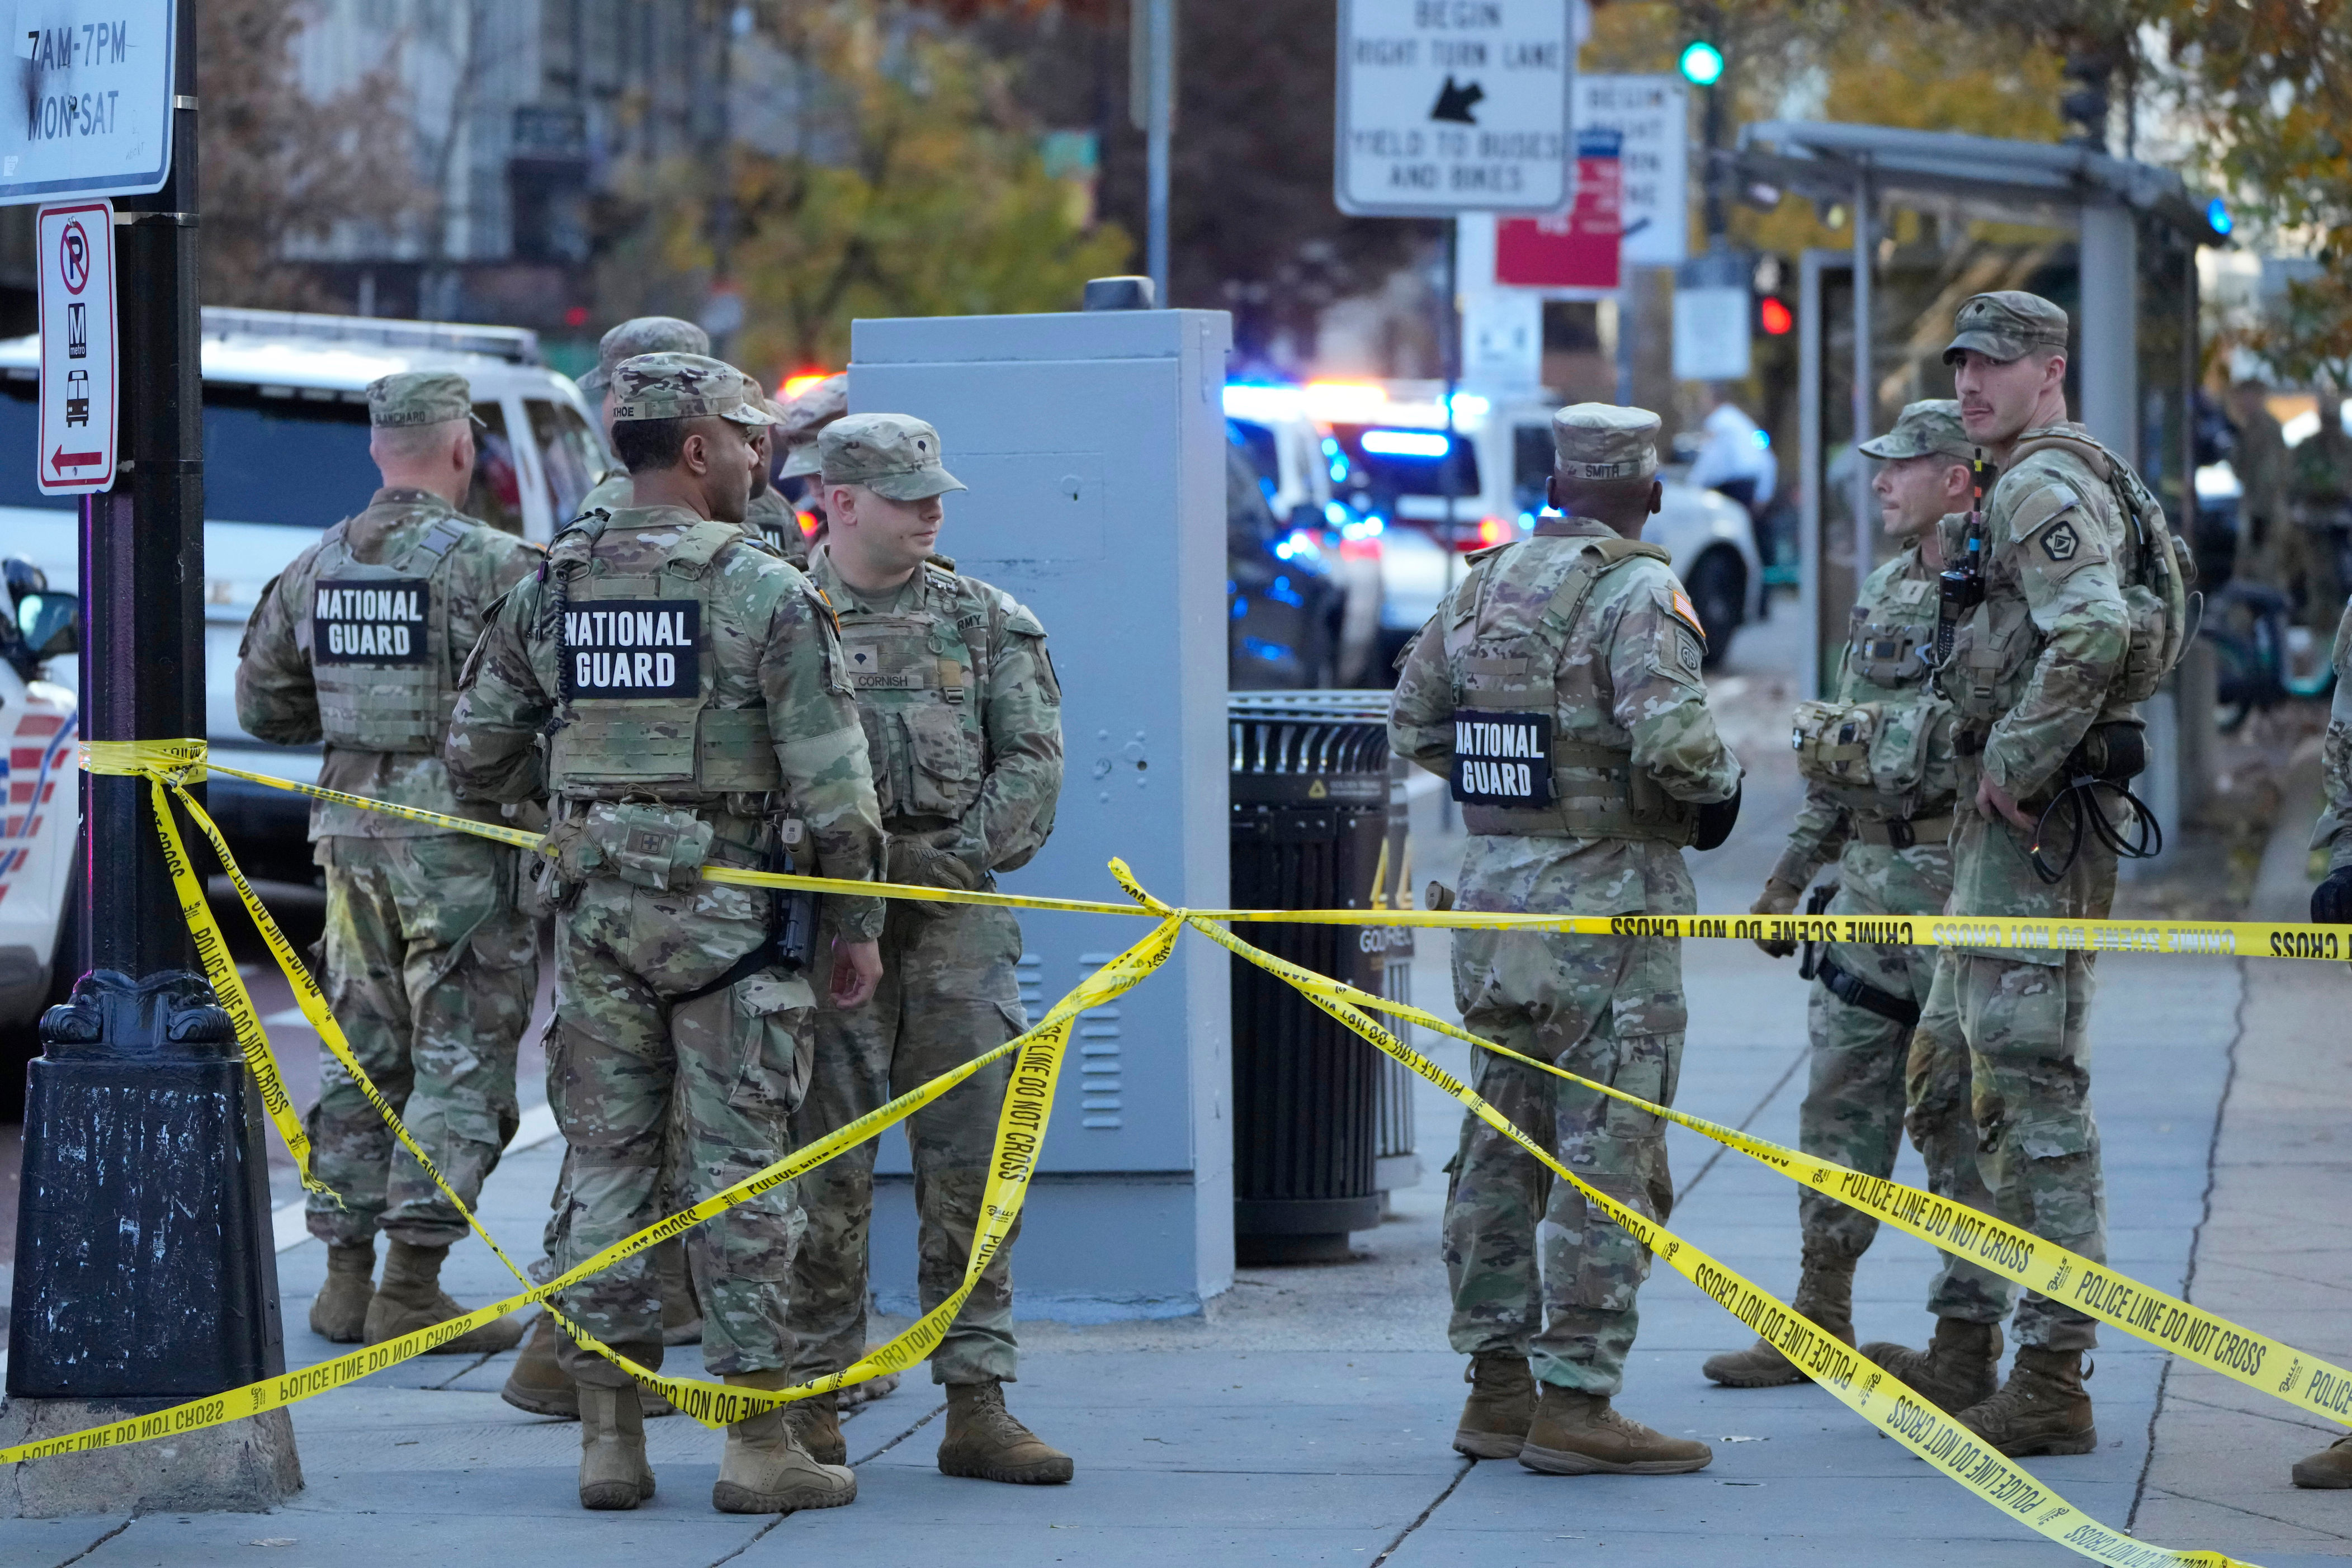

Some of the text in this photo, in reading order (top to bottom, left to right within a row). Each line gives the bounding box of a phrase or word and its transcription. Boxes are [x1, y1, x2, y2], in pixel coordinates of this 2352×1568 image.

[29, 20, 126, 72] 7AM-7PM
[1356, 38, 1558, 71] RIGHT TURN LANE
[28, 90, 119, 141] MON-SAT
[69, 306, 85, 345] M
[70, 346, 86, 355] metro
[1585, 464, 1619, 478] SMITH
[315, 588, 422, 621] NATIONAL
[328, 624, 410, 656] GUARD
[564, 611, 692, 649] NATIONAL
[957, 615, 983, 631] RMY
[576, 653, 675, 688] GUARD
[858, 676, 908, 687] CORNISH
[1455, 720, 1545, 759] NATIONAL
[1462, 762, 1532, 797] GUARD
[1770, 921, 1837, 942] SCENE
[1845, 922, 1912, 944] CRIME
[2270, 932, 2338, 958] CROSS
[1021, 1045, 1055, 1077] LINE
[255, 1064, 289, 1115] CROSS
[1015, 1076, 1047, 1098] DO
[1009, 1101, 1043, 1132] NOT
[998, 1131, 1036, 1183] CROSS
[986, 1205, 1014, 1217] GALLS
[1840, 1173, 1896, 1212] POLICE
[1891, 1188, 1931, 1227] LINE
[1926, 1203, 1952, 1236] DO
[1948, 1212, 1986, 1251] NOT
[1980, 1226, 2035, 1273] CROSS
[2047, 1255, 2068, 1292] GALLS
[1734, 1290, 1767, 1330] NOT
[1760, 1306, 1786, 1341] DO
[2074, 1271, 2267, 1376] POLICE LINE DO NOT CROSS
[1779, 1319, 1815, 1362] LINE
[1808, 1337, 1858, 1391] POLICE
[2279, 1356, 2298, 1393] GALLS
[682, 1387, 712, 1420] NOT
[1860, 1371, 1882, 1408] GALLS
[715, 1393, 736, 1424] DO
[1886, 1395, 2047, 1514] POLICE LINE DO NOT CROSS
[2063, 1524, 2114, 1556] CROSS
[2099, 1539, 2140, 1561] NOT
[2128, 1550, 2155, 1567] DO
